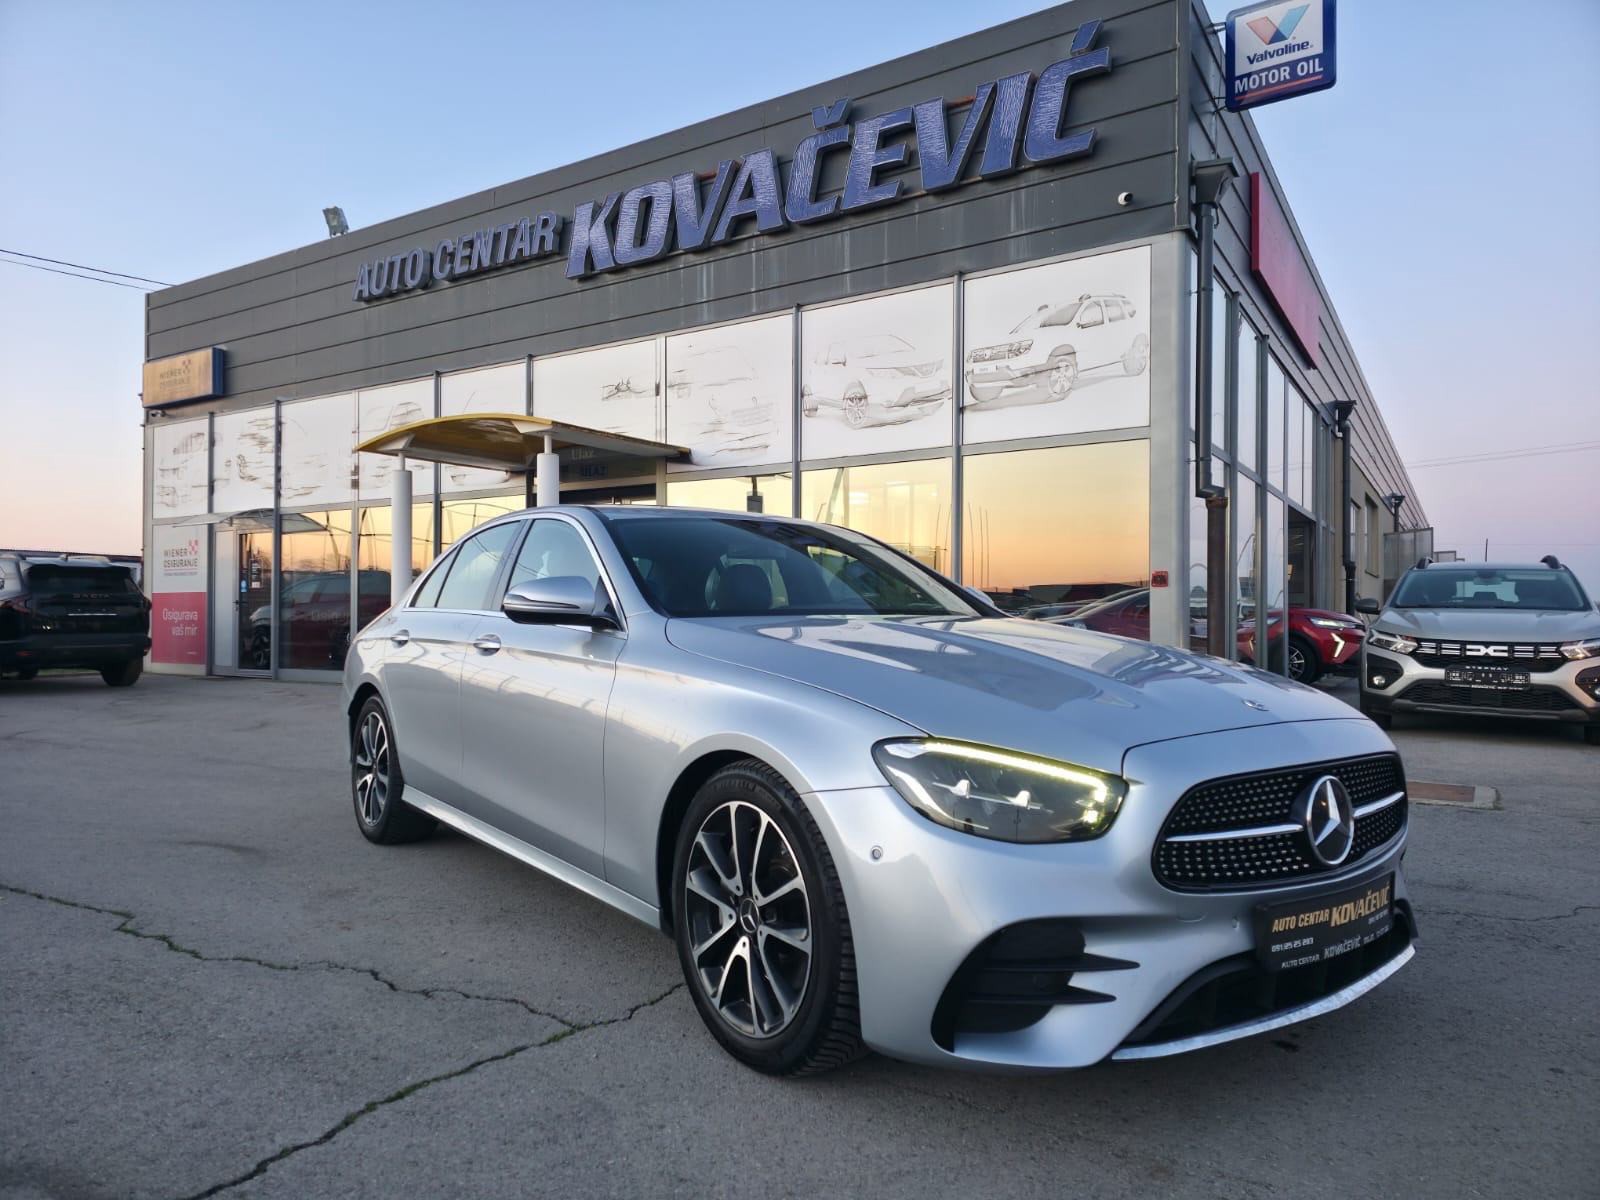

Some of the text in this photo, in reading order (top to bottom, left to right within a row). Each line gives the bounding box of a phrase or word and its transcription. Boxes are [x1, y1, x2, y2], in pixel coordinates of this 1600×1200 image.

[1247, 40, 1310, 65] Valvoline
[1235, 58, 1324, 93] MOTOR OIL
[355, 20, 1112, 300] AUTO CENTAR KOVAČEVIĆ
[162, 607, 198, 623] Osigurava
[1272, 916, 1297, 932] AUTO
[1298, 909, 1329, 927] CENTAR
[1330, 882, 1390, 927] KOVAČEVIĆ
